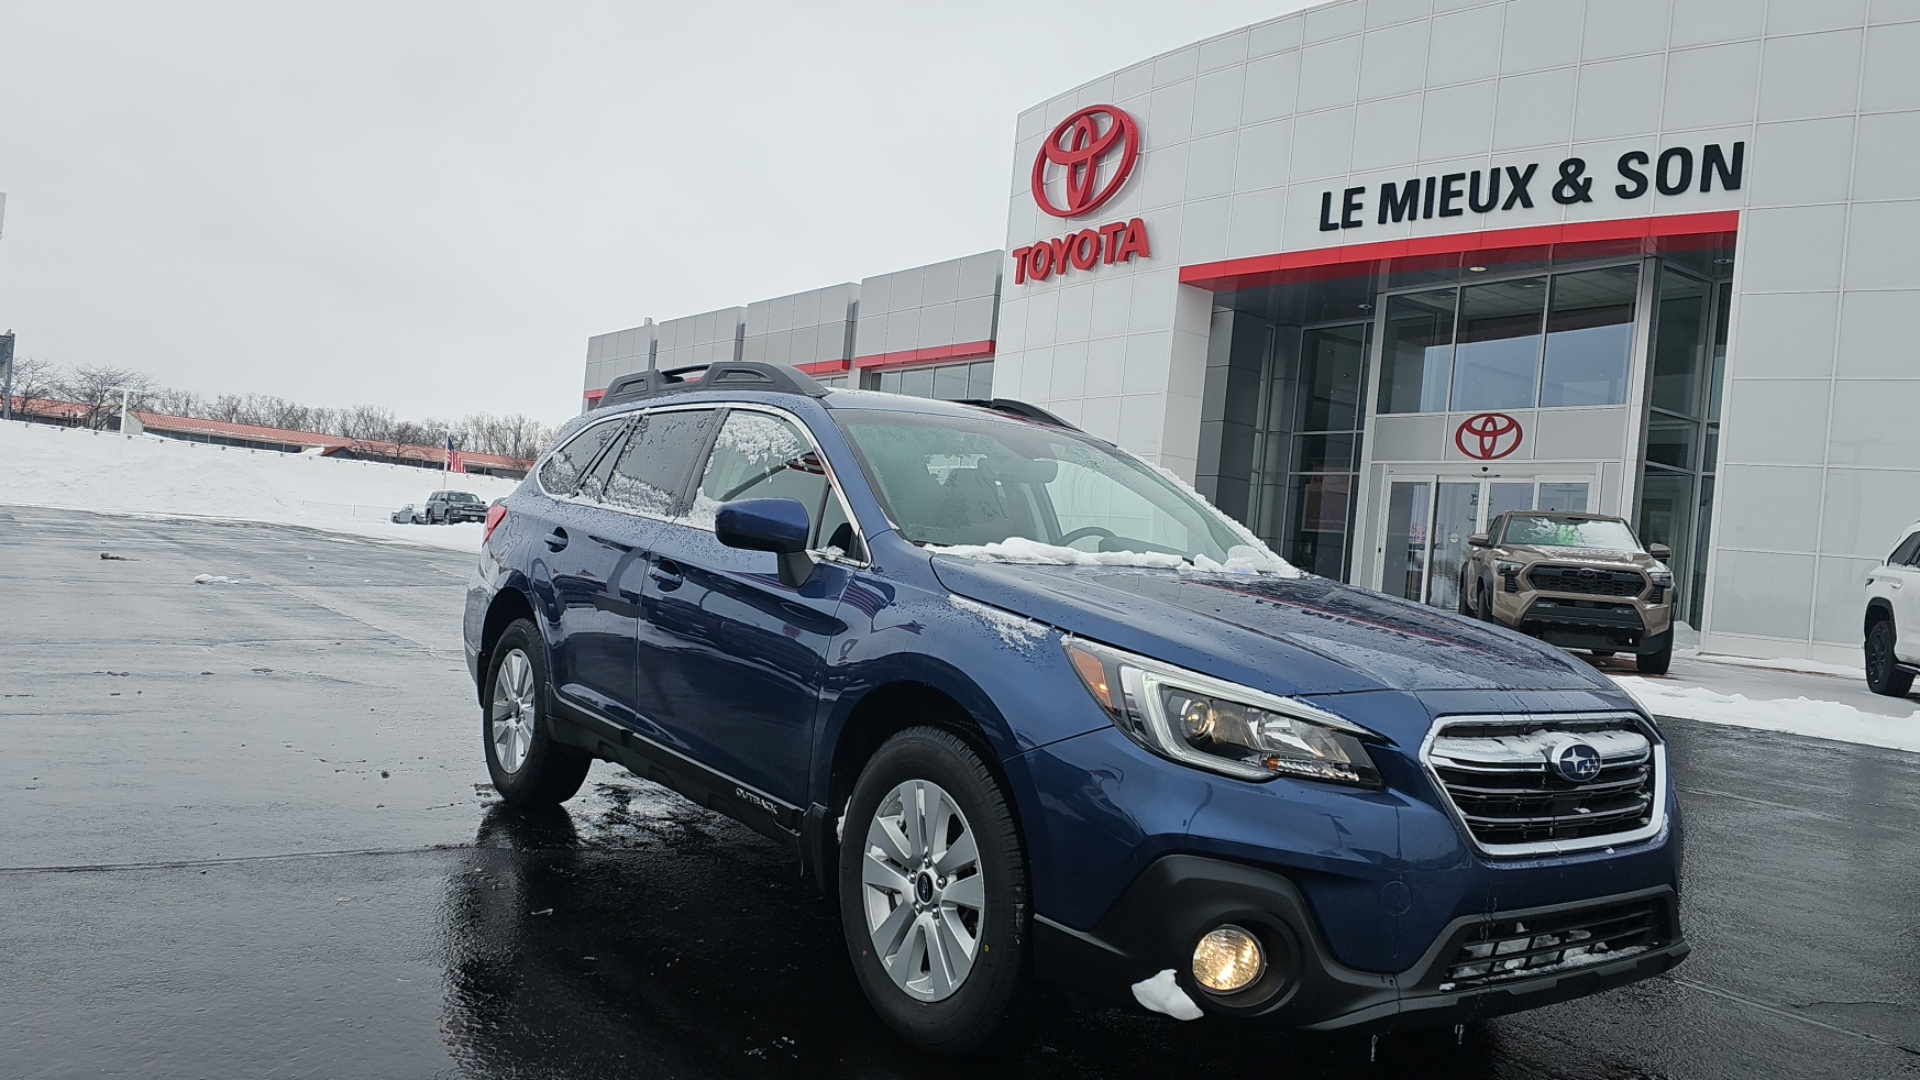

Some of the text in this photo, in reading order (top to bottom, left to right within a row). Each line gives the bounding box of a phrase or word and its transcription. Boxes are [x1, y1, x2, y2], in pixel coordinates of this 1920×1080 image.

[1319, 141, 1745, 232] LE MIEUX & SON
[1013, 217, 1150, 286] TOYOTA
